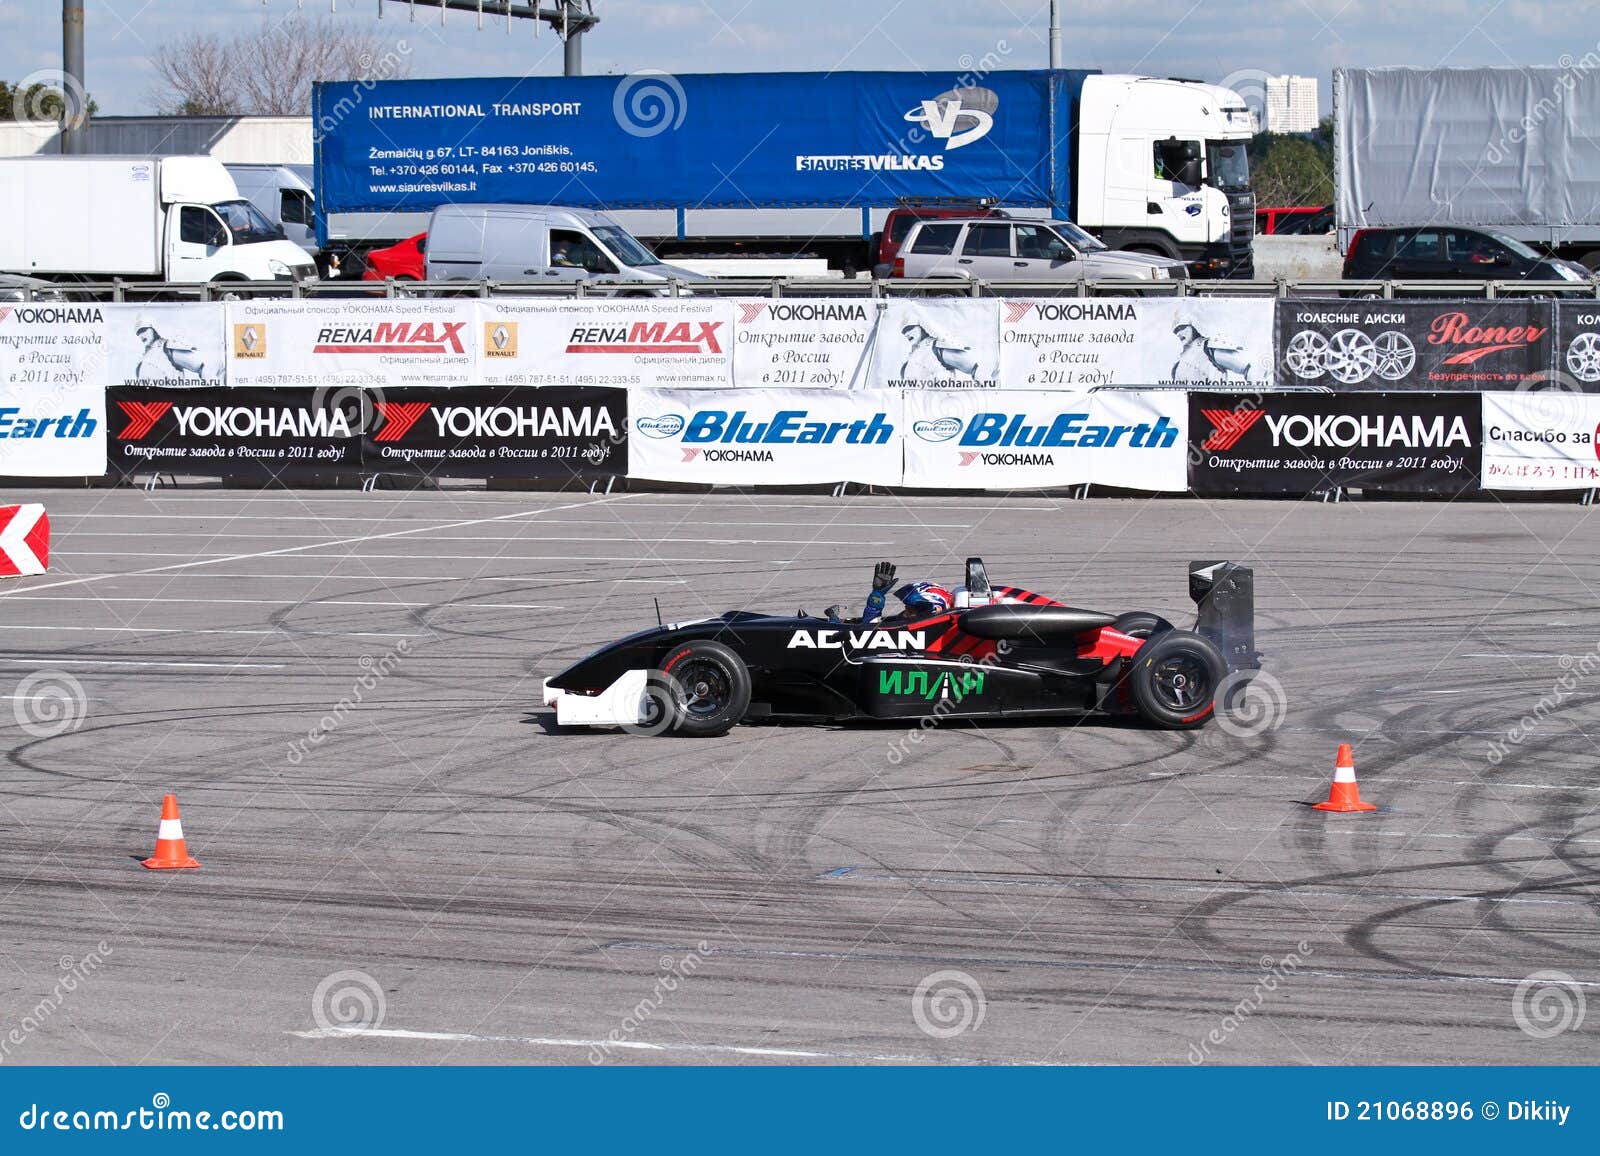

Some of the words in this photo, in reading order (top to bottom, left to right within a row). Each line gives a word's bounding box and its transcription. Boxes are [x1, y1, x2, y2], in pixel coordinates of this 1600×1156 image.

[369, 104, 486, 119] INTERNATIONAL
[492, 103, 581, 116] TRANSPORT
[369, 146, 423, 160] Žemaičių
[481, 145, 519, 157] 84163
[522, 143, 573, 156] Joniškis,
[419, 164, 438, 174] 426
[440, 164, 478, 175] 60144,
[483, 163, 502, 173] Fax
[507, 162, 535, 173] +370
[538, 162, 558, 172] 426
[560, 161, 597, 173] 60145,
[370, 181, 477, 193] www.siauresvilkas.lt
[14, 308, 104, 323] YOKOHAMA
[245, 306, 304, 315] Официальный
[307, 307, 340, 315] спонсор
[342, 305, 394, 313] YOKOHAMA
[396, 305, 422, 315] Speed
[424, 305, 456, 313] Festival
[496, 304, 558, 314] Официальный
[560, 304, 594, 313] спонсор
[597, 305, 650, 313] YOKOHAMA
[651, 304, 679, 314] Speed
[681, 304, 713, 313] Festival
[768, 305, 867, 321] YOKOHAMA
[1036, 304, 1137, 321] YOKOHAMA
[1296, 313, 1360, 323] КОЛЕСНЫЕ
[1365, 314, 1405, 324] ДИСКИ
[1427, 311, 1548, 345] Roner
[61, 329, 102, 345] завода
[738, 330, 815, 347] Открытие
[820, 330, 864, 343] завода
[1004, 330, 1084, 347] Открытие
[1088, 330, 1134, 343] завода
[29, 351, 71, 364] России
[380, 355, 440, 365] Официальный
[443, 356, 469, 365] дилер
[634, 356, 697, 365] Официальный
[699, 357, 726, 366] дилер
[783, 350, 830, 364] России
[1050, 350, 1099, 364] России
[20, 370, 49, 382] 2011
[53, 369, 85, 385] году!
[124, 378, 220, 387] www.yokohama.ru
[401, 374, 468, 382] www.renamax.ru
[505, 375, 527, 384] (495)
[575, 376, 597, 385] (495)
[599, 376, 641, 384] 22-333-55
[774, 370, 804, 383] 2011
[810, 369, 844, 385] году!
[888, 378, 995, 388] www.yokohama.ru
[1040, 370, 1073, 384] 2011
[1079, 369, 1113, 386] году!
[172, 406, 351, 437] YOKOHAMA
[431, 407, 615, 437] YOKOHAMA
[680, 410, 894, 444] BluEarth
[958, 413, 1178, 448] BluEarth
[1265, 415, 1471, 447] YOKOHAMA
[1490, 426, 1566, 443] Спасибо
[1572, 433, 1591, 443] за
[124, 444, 187, 460] Открытие
[190, 443, 225, 457] завода
[237, 445, 274, 457] России
[288, 445, 314, 457] 2011
[317, 445, 345, 460] году!
[382, 446, 446, 461] Открытие
[449, 445, 486, 458] завода
[498, 446, 537, 458] России
[551, 446, 577, 458] 2011
[580, 446, 610, 462] году!
[703, 450, 774, 462] YOKOHAMA
[981, 454, 1054, 465] YOKOHAMA
[1208, 455, 1279, 472] Открытие
[1284, 454, 1325, 470] завода
[1338, 456, 1383, 469] России
[1396, 456, 1426, 469] 2011
[1430, 456, 1463, 472] году!
[786, 630, 926, 650] ADVAN
